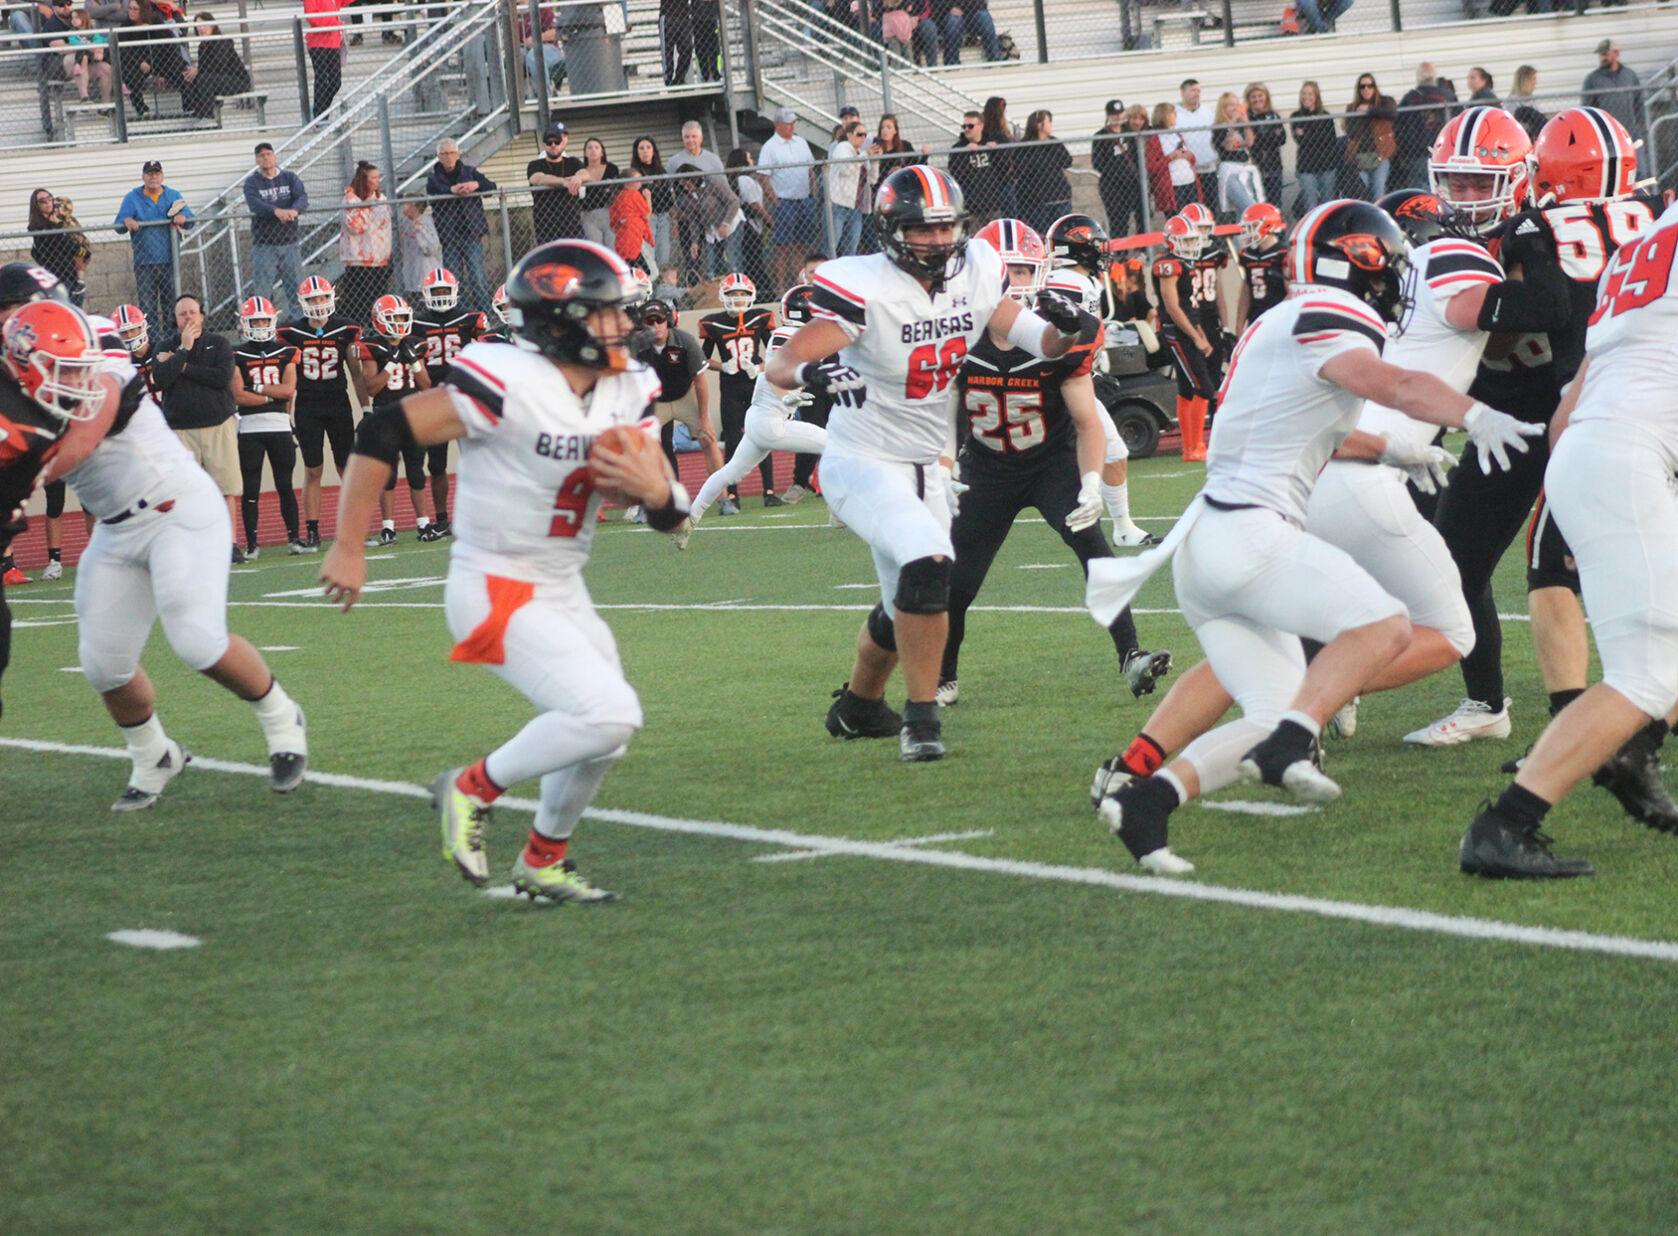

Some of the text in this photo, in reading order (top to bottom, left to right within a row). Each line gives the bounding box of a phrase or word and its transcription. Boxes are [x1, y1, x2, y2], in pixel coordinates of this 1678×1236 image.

[1158, 263, 1172, 275] 13
[1251, 268, 1266, 299] 5
[427, 334, 461, 365] 26
[249, 366, 281, 385] 10
[967, 376, 1039, 387] HARBOR CREEK
[965, 388, 1046, 451] 25
[535, 432, 594, 461] BEAV
[547, 466, 596, 538] 9
